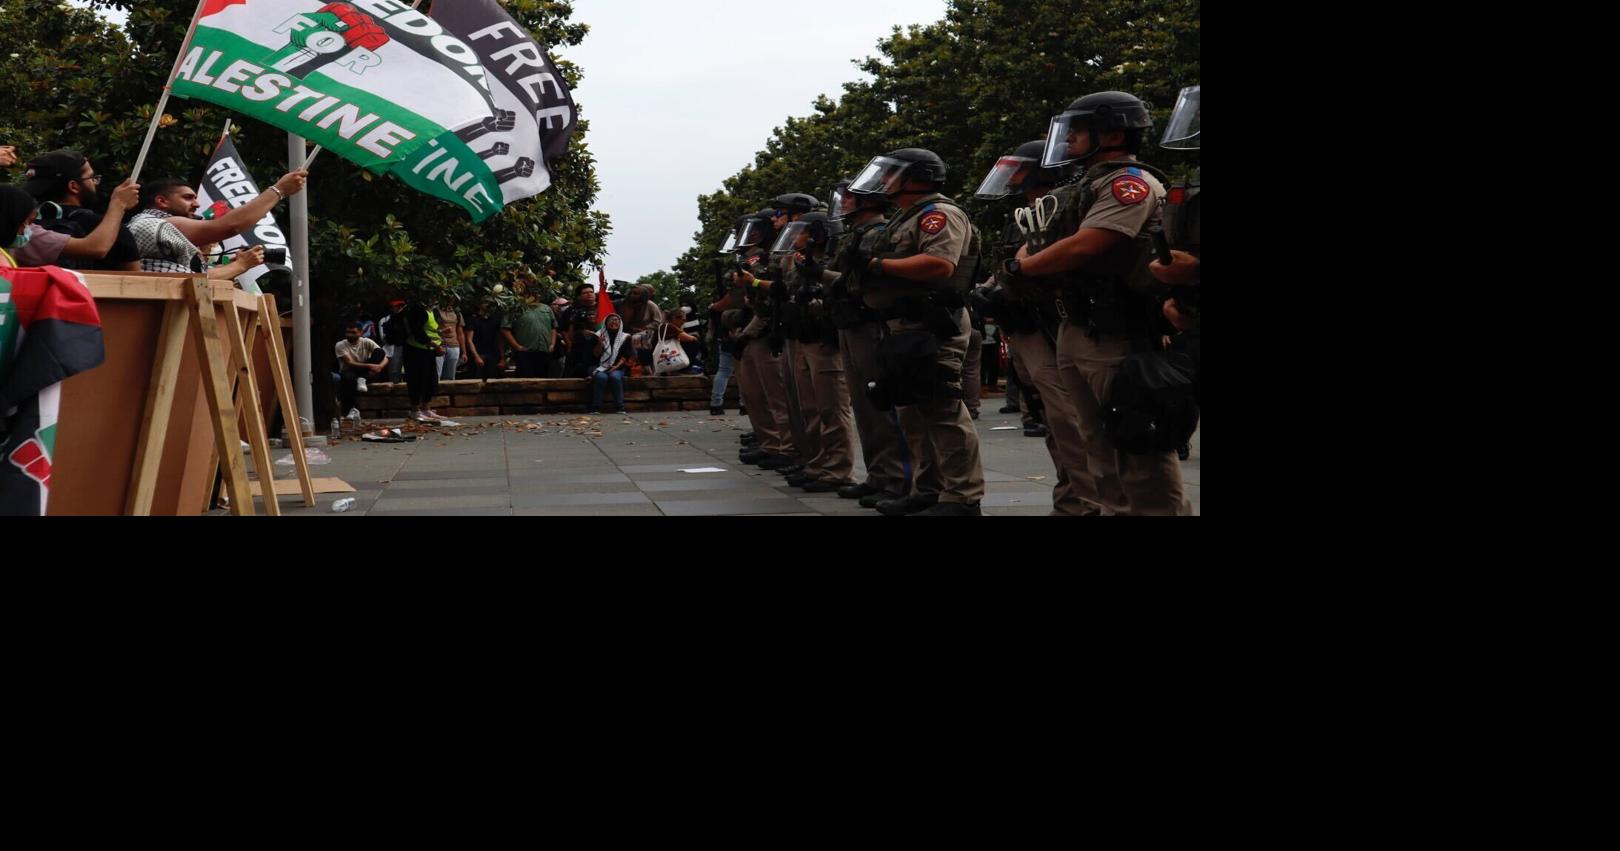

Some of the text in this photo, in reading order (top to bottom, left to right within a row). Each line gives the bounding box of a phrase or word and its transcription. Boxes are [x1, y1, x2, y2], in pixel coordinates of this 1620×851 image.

[272, 13, 382, 76] FOR
[468, 21, 571, 131] FREE
[175, 46, 417, 158] ALESTINE
[411, 138, 494, 214] INE
